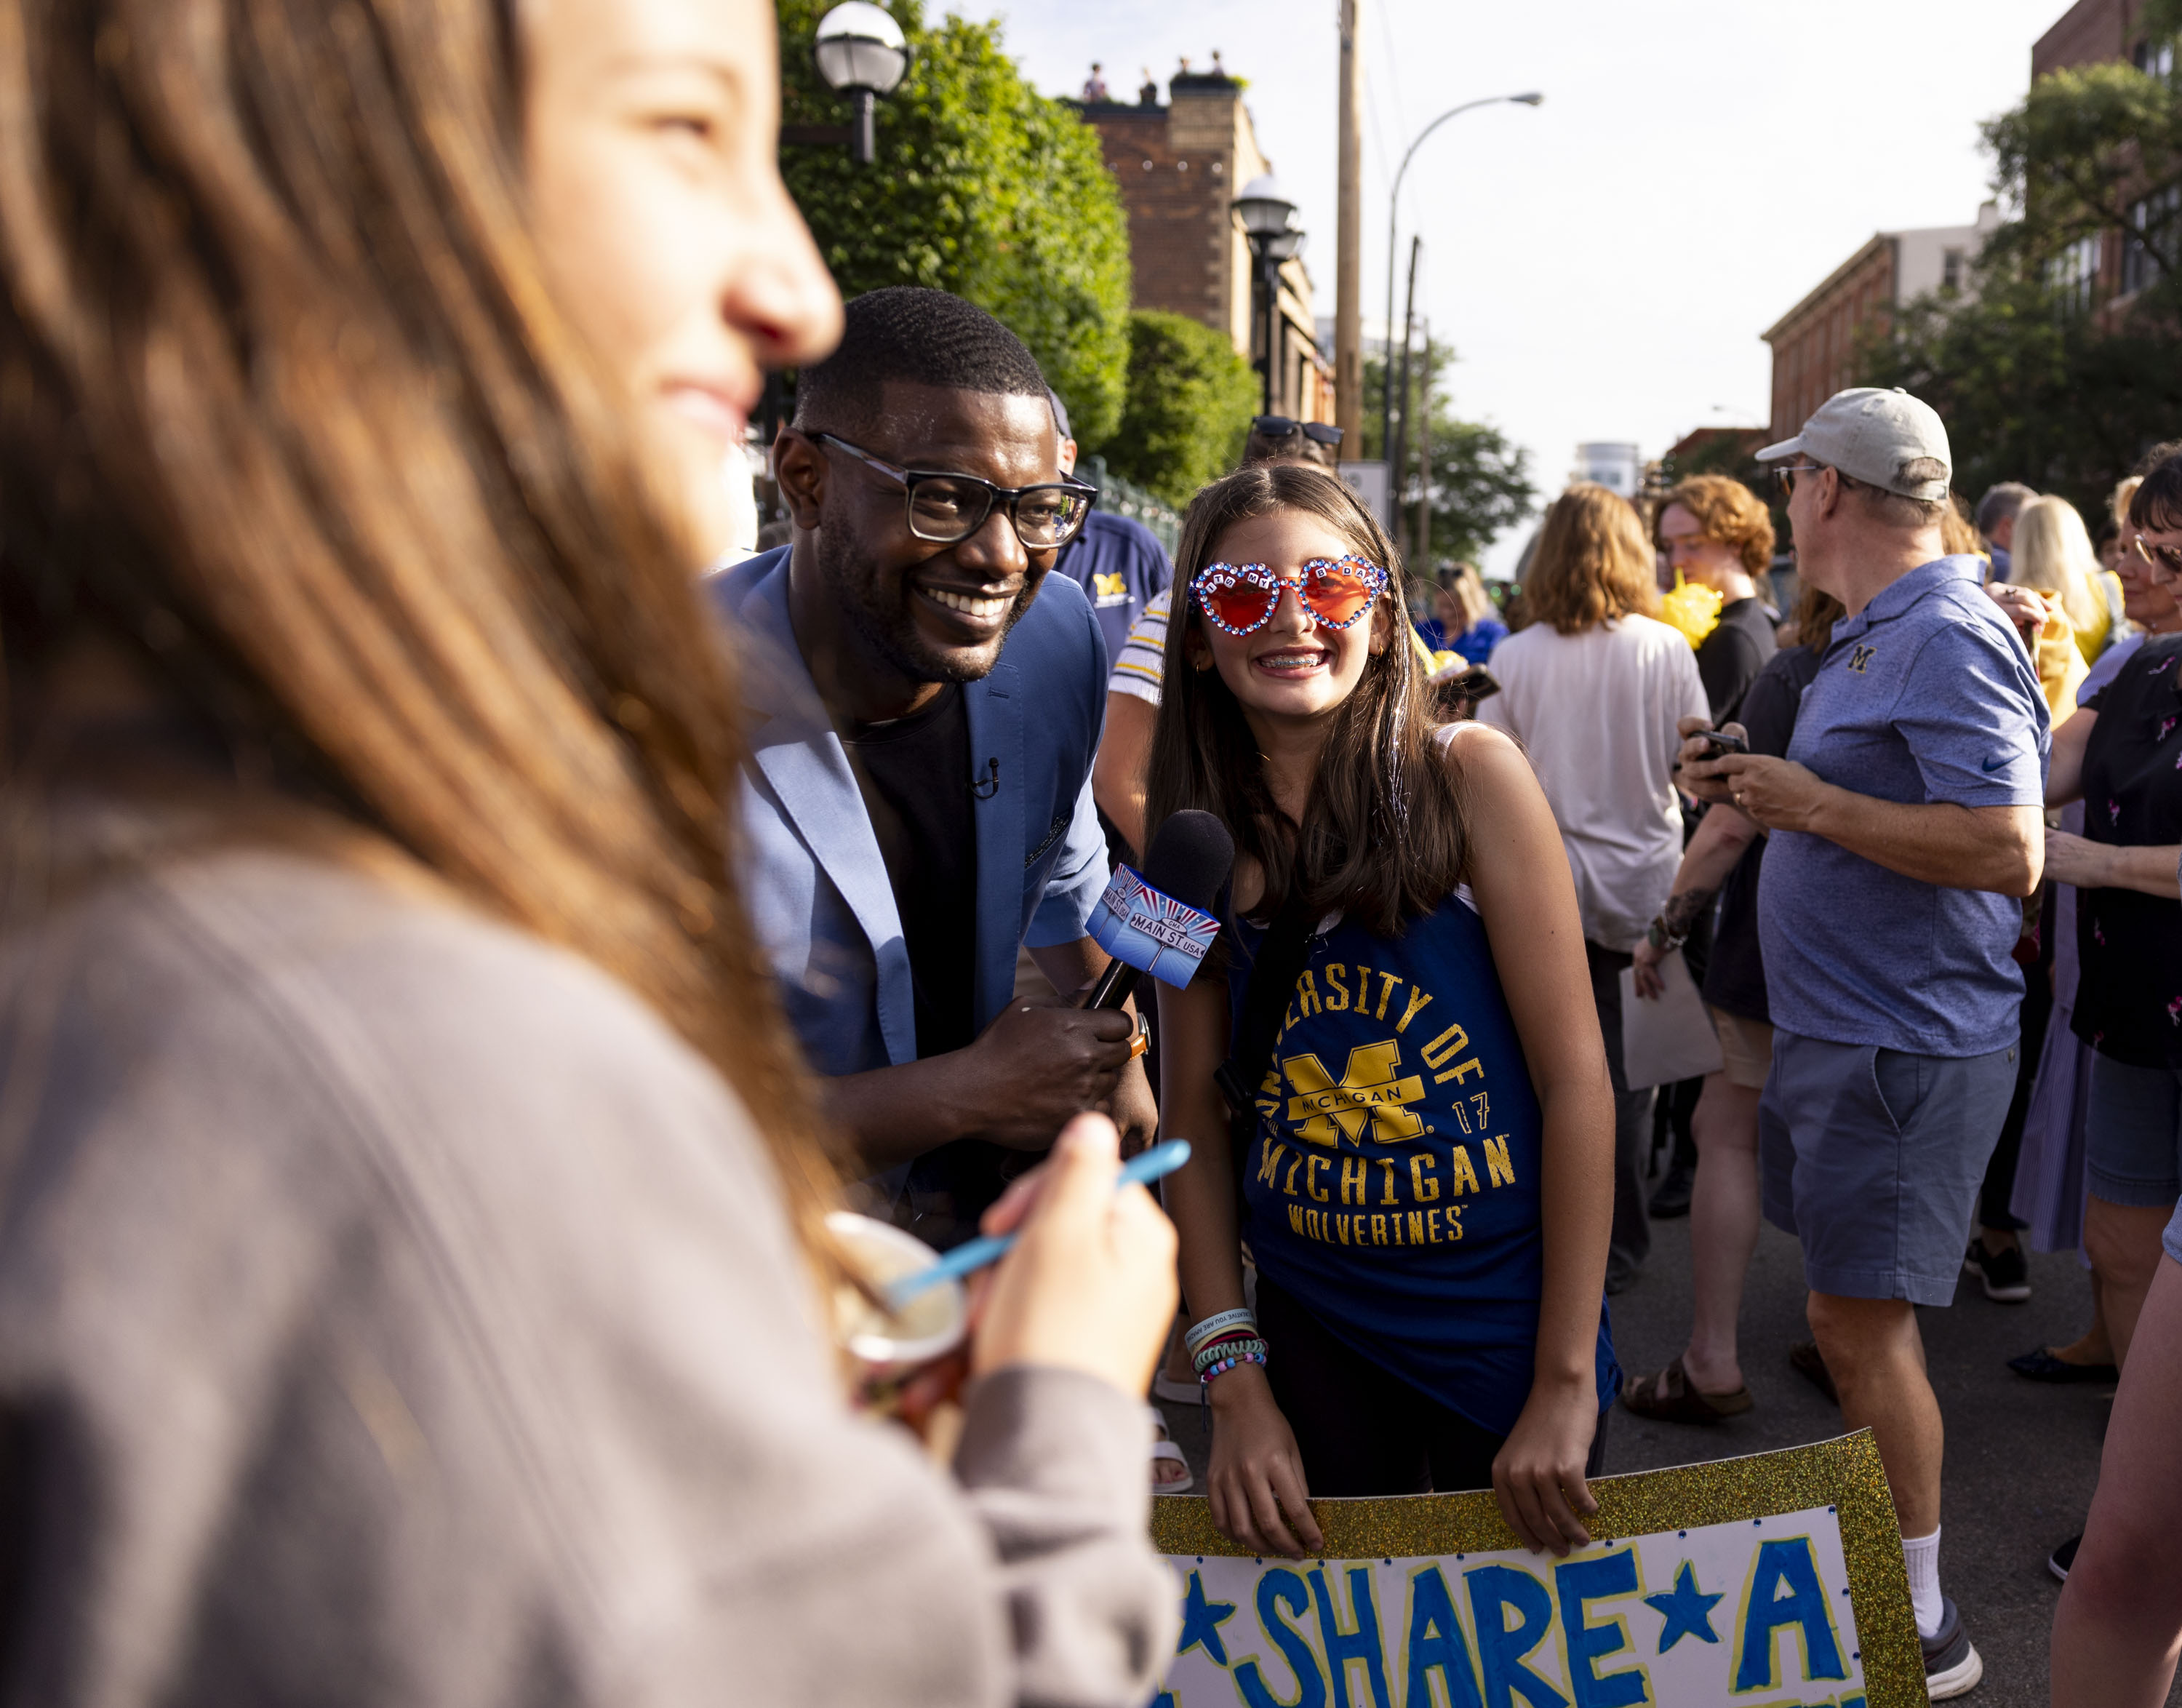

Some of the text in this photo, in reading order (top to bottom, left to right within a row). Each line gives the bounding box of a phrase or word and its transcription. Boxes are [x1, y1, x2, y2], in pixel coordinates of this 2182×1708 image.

[1207, 575, 1235, 592] ITS
[1248, 574, 1268, 588] MY
[1343, 567, 1371, 587] DAY
[1846, 645, 1877, 674] M
[1103, 888, 1118, 906] MAIN
[1134, 915, 1167, 938] MAIN
[1183, 941, 1200, 957] USA
[1167, 920, 1180, 930] GMA
[1420, 1023, 1484, 1085] OF
[1302, 1087, 1402, 1112] MICHIGAN
[1452, 1091, 1490, 1134] 17
[1257, 1134, 1516, 1205] MICHIGAN
[1287, 1204, 1464, 1246] WOLVERINES
[1203, 1321, 1215, 1331] ARE
[1215, 1316, 1227, 1325] YOU
[1232, 1535, 1850, 1708] SHARE A
